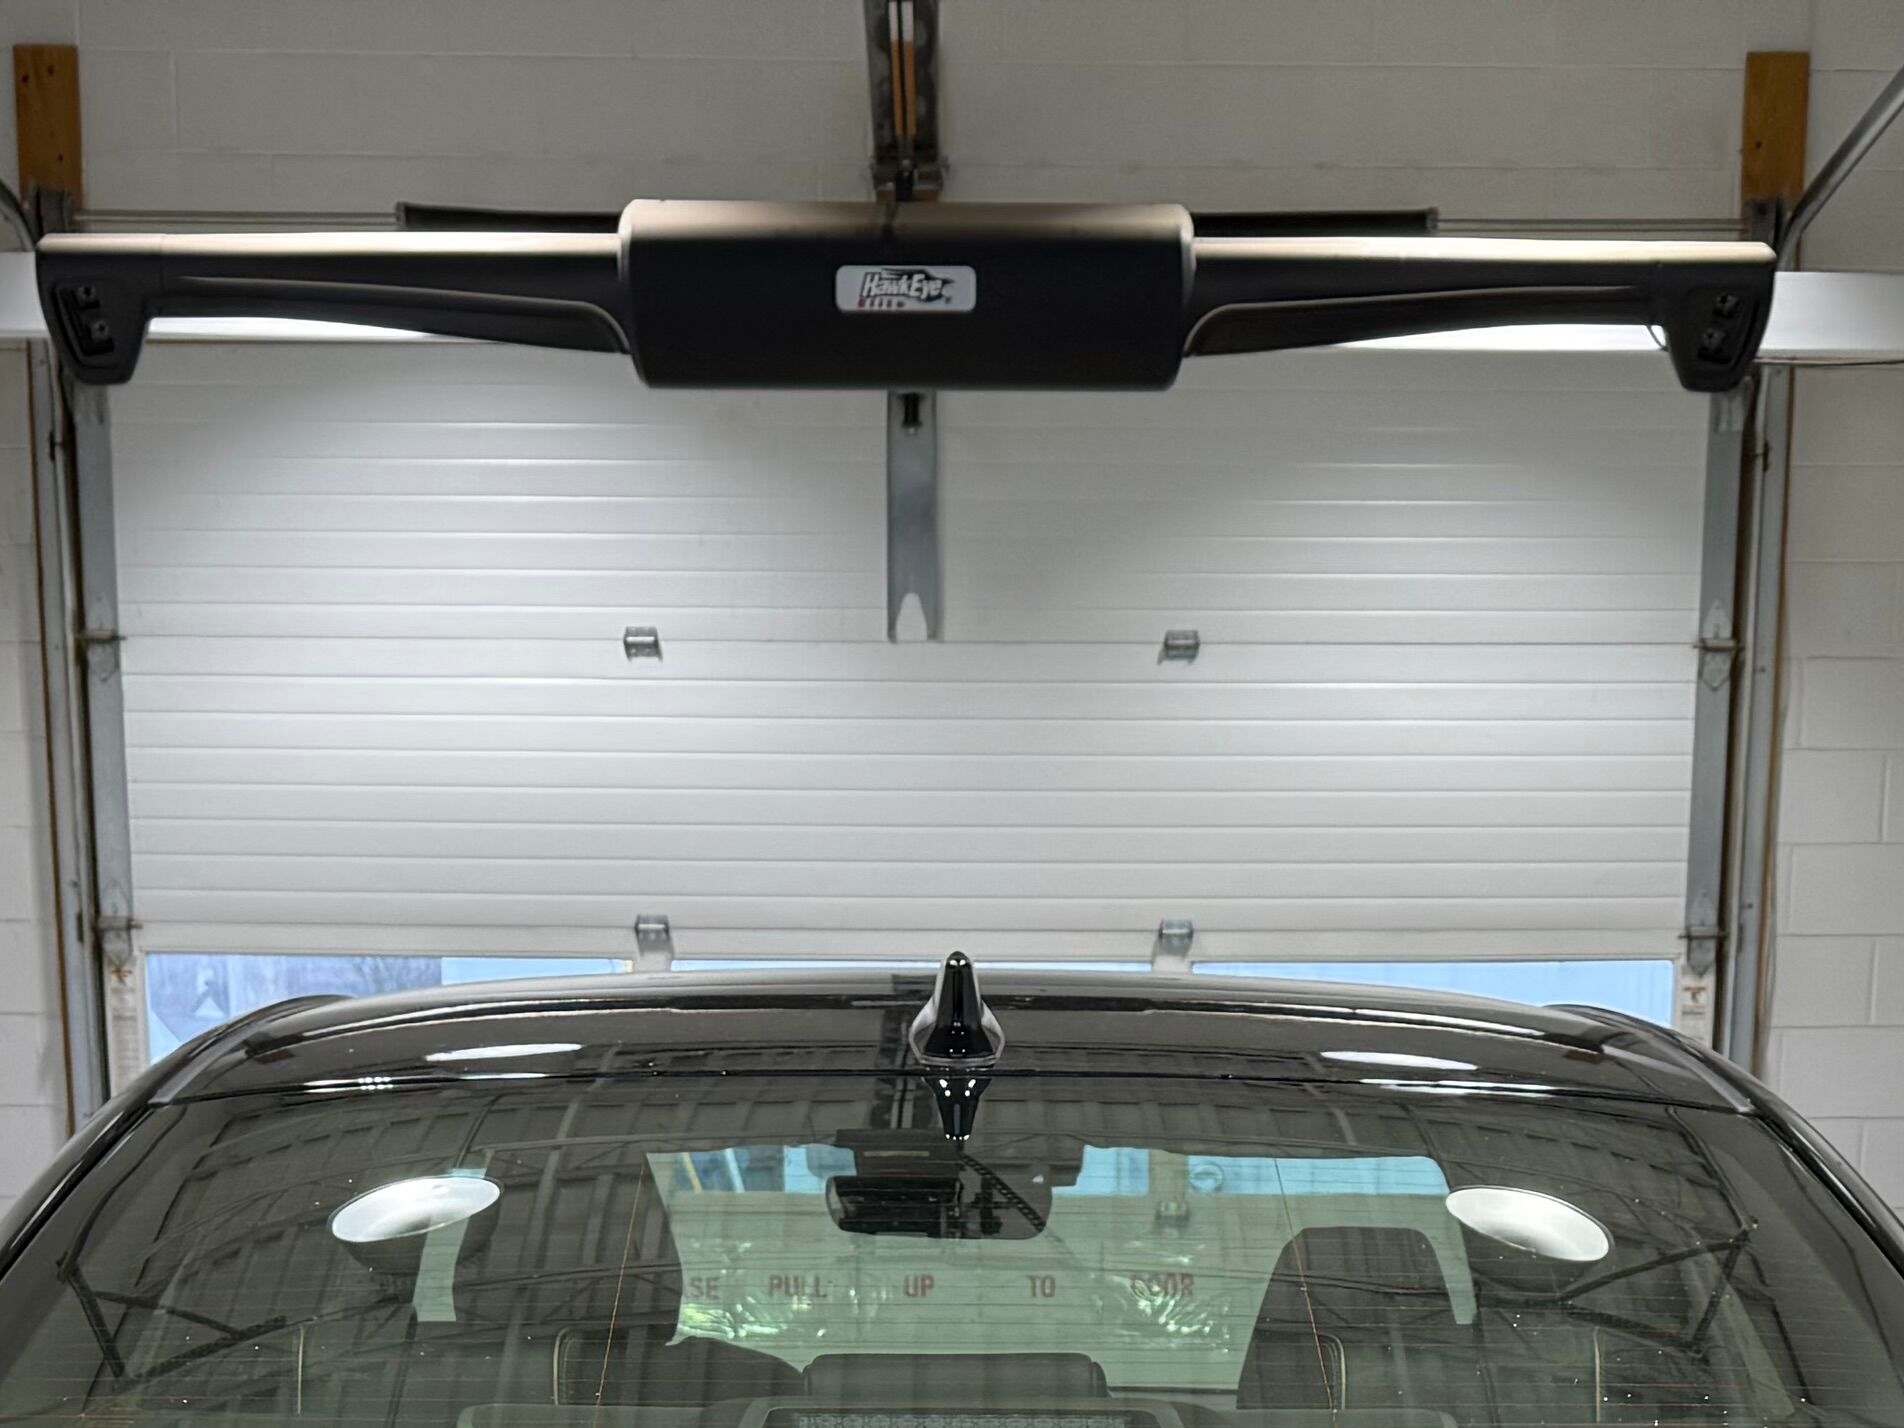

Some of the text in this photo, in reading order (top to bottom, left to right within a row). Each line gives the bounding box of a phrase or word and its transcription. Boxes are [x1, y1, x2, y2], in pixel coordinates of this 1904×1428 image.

[861, 271, 945, 301] HawkEye
[768, 1273, 828, 1298] PULL
[903, 1273, 935, 1297] UP
[1025, 1274, 1057, 1298] TO
